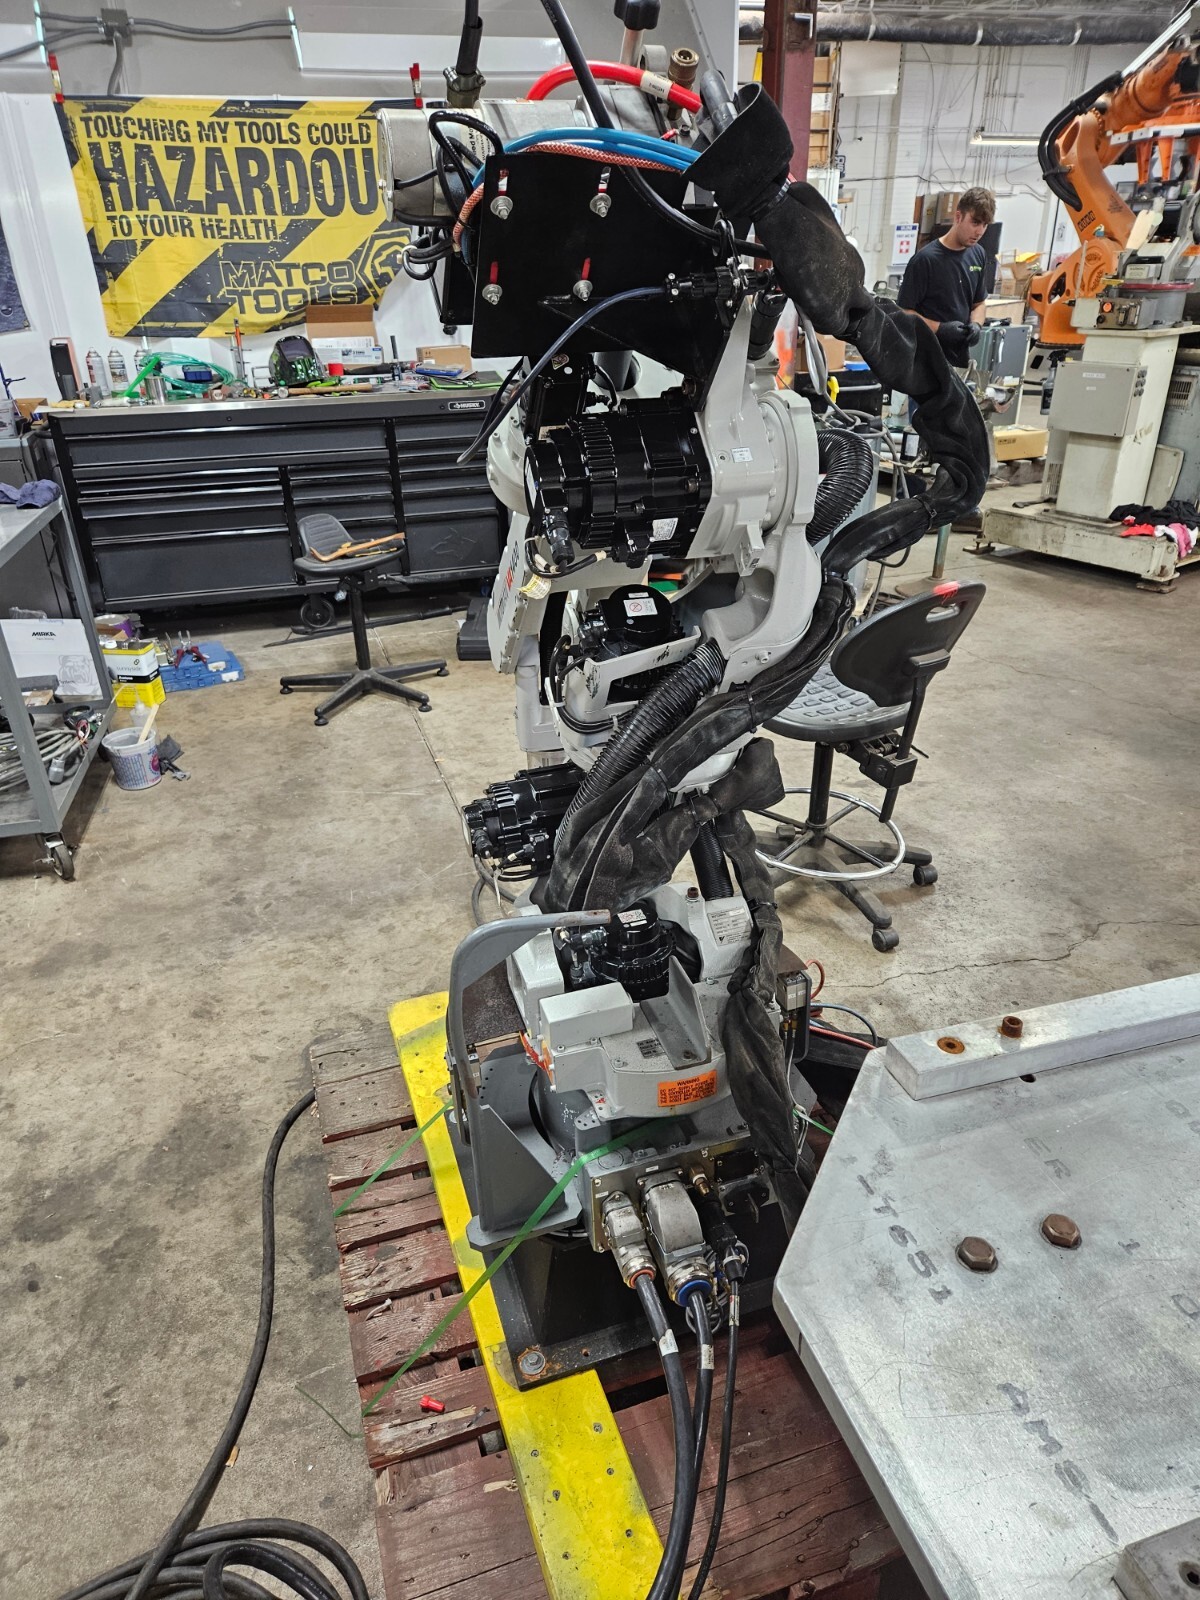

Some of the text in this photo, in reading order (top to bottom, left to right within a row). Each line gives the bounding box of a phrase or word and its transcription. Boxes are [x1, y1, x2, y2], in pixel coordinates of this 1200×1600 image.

[80, 115, 371, 145] TOUCHING MY TOOLS COULD
[87, 141, 379, 217] HAZARDOU
[107, 214, 279, 240] TO YOUR HEALTH
[219, 259, 357, 288] MATCO
[225, 283, 358, 314] TOOLS
